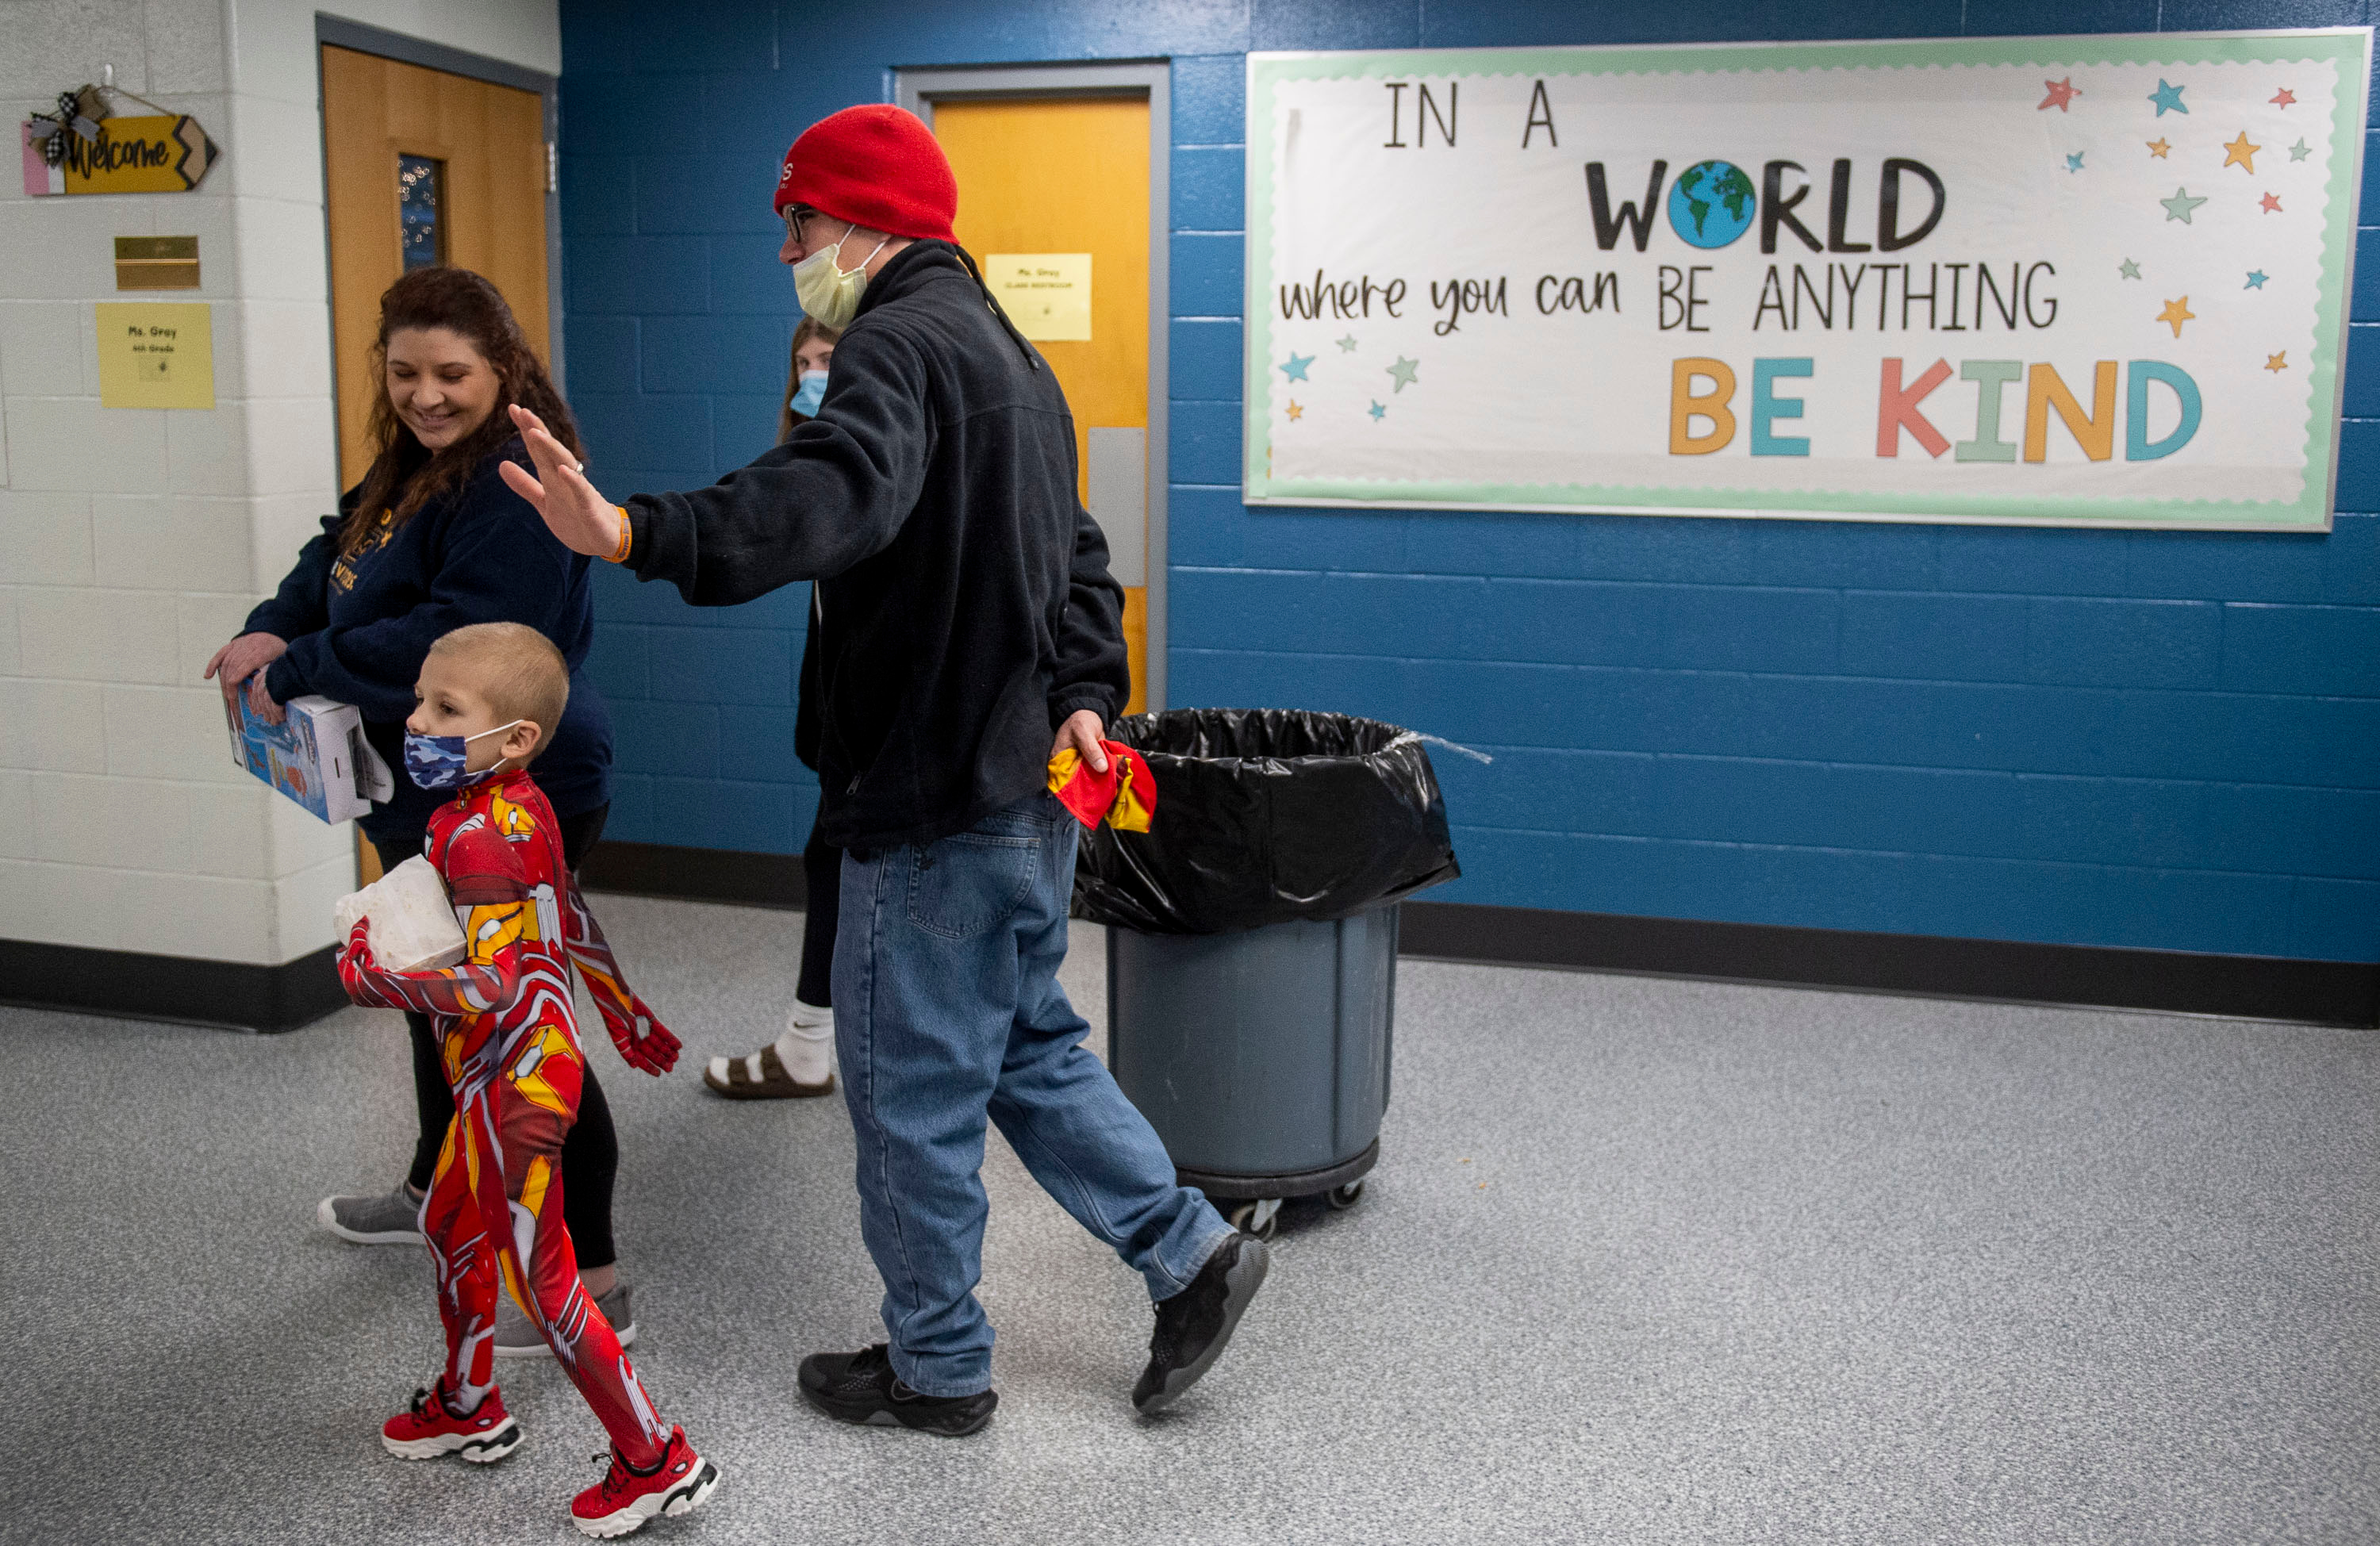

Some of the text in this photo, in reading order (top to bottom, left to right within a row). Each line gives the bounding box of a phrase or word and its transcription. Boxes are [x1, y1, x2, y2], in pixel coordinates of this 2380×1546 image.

[1384, 78, 1558, 150] IN A
[69, 129, 170, 180] Welcome
[1584, 157, 1947, 256] WORLD
[1280, 260, 2059, 337] where you can BE ANYTHING
[1668, 355, 2204, 466] BE KIND
